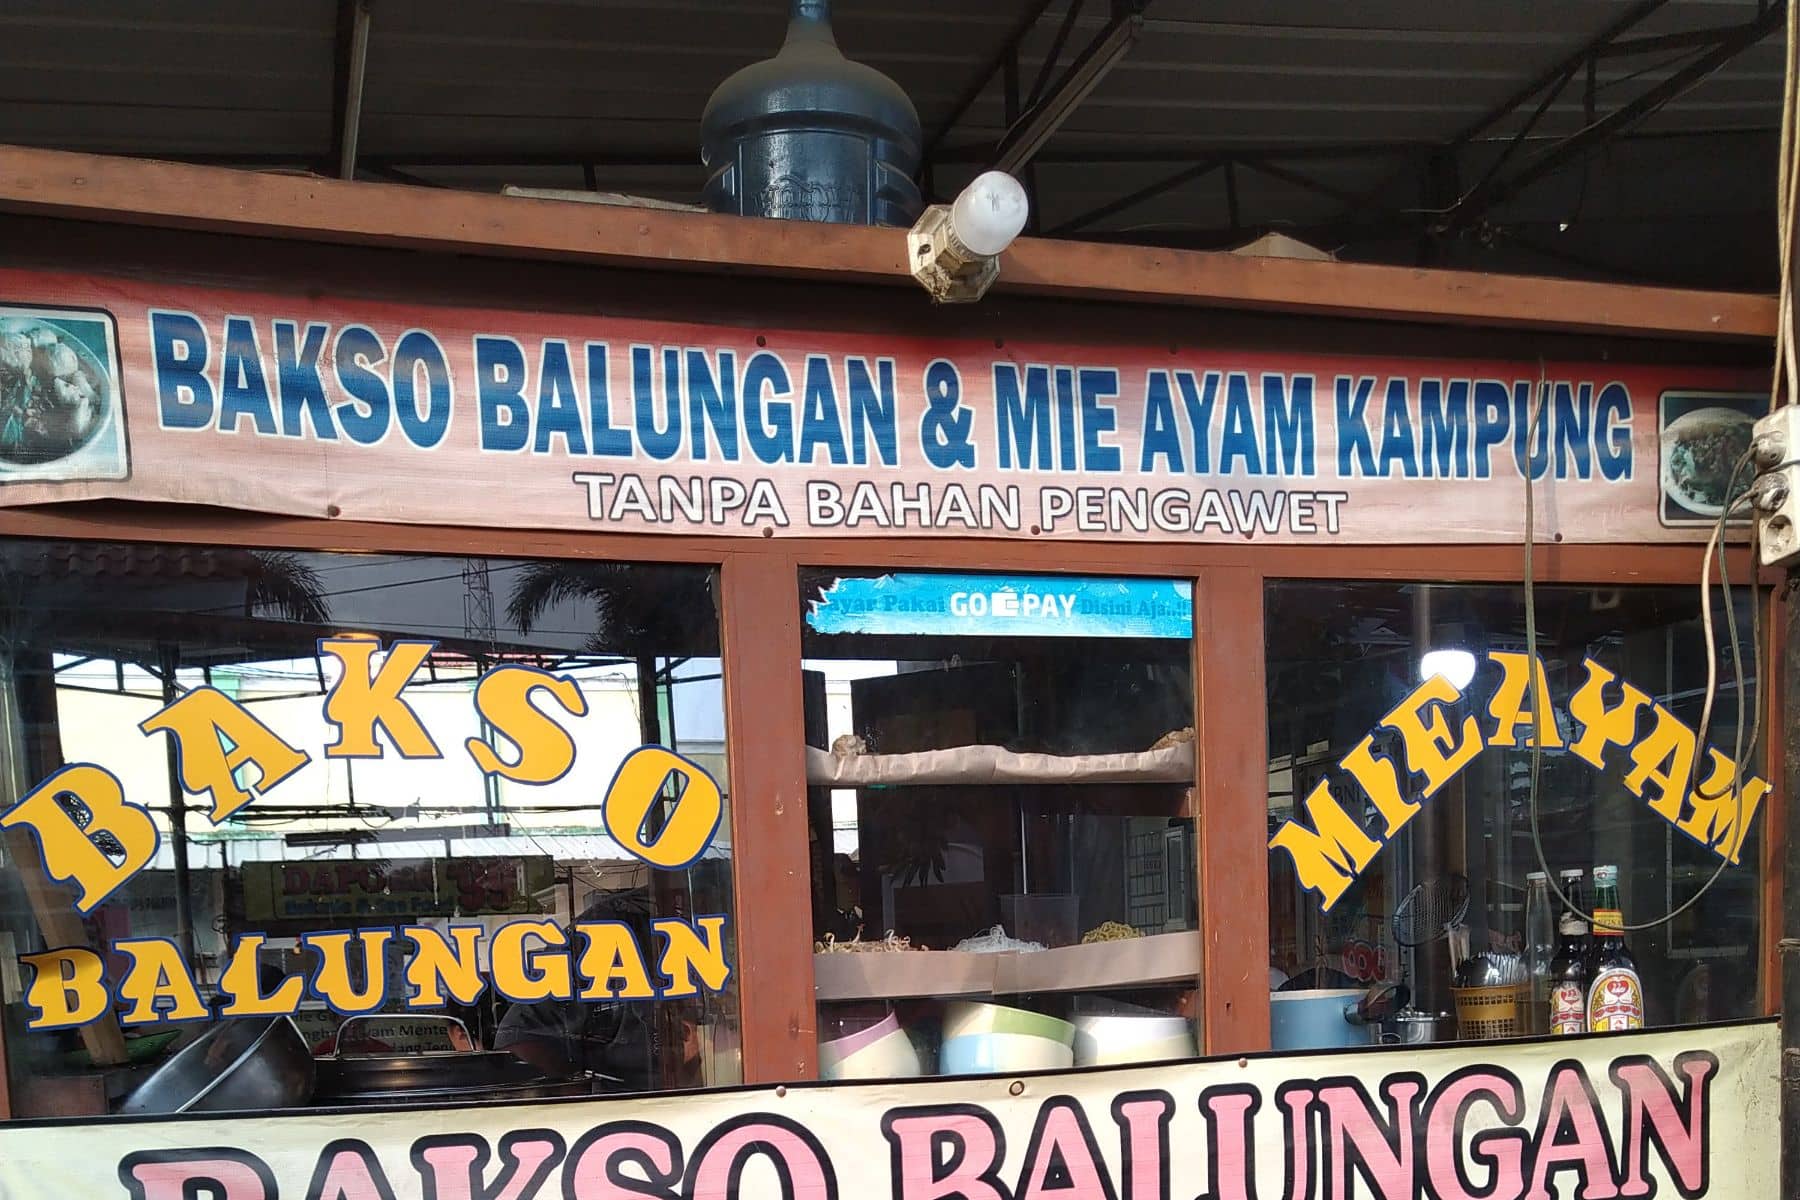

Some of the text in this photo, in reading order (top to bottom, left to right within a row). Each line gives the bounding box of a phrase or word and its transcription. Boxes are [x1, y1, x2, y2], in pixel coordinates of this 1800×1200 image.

[150, 308, 1635, 484] BAKSO BALUNGAN & MIE AYAM KAMPUNG
[574, 472, 1348, 537] TANPA BAHAN PENGAWET
[950, 592, 988, 617] GO
[1022, 594, 1076, 617] PAY
[0, 636, 724, 918] BAKSO
[20, 914, 731, 1032] BALUNGAN
